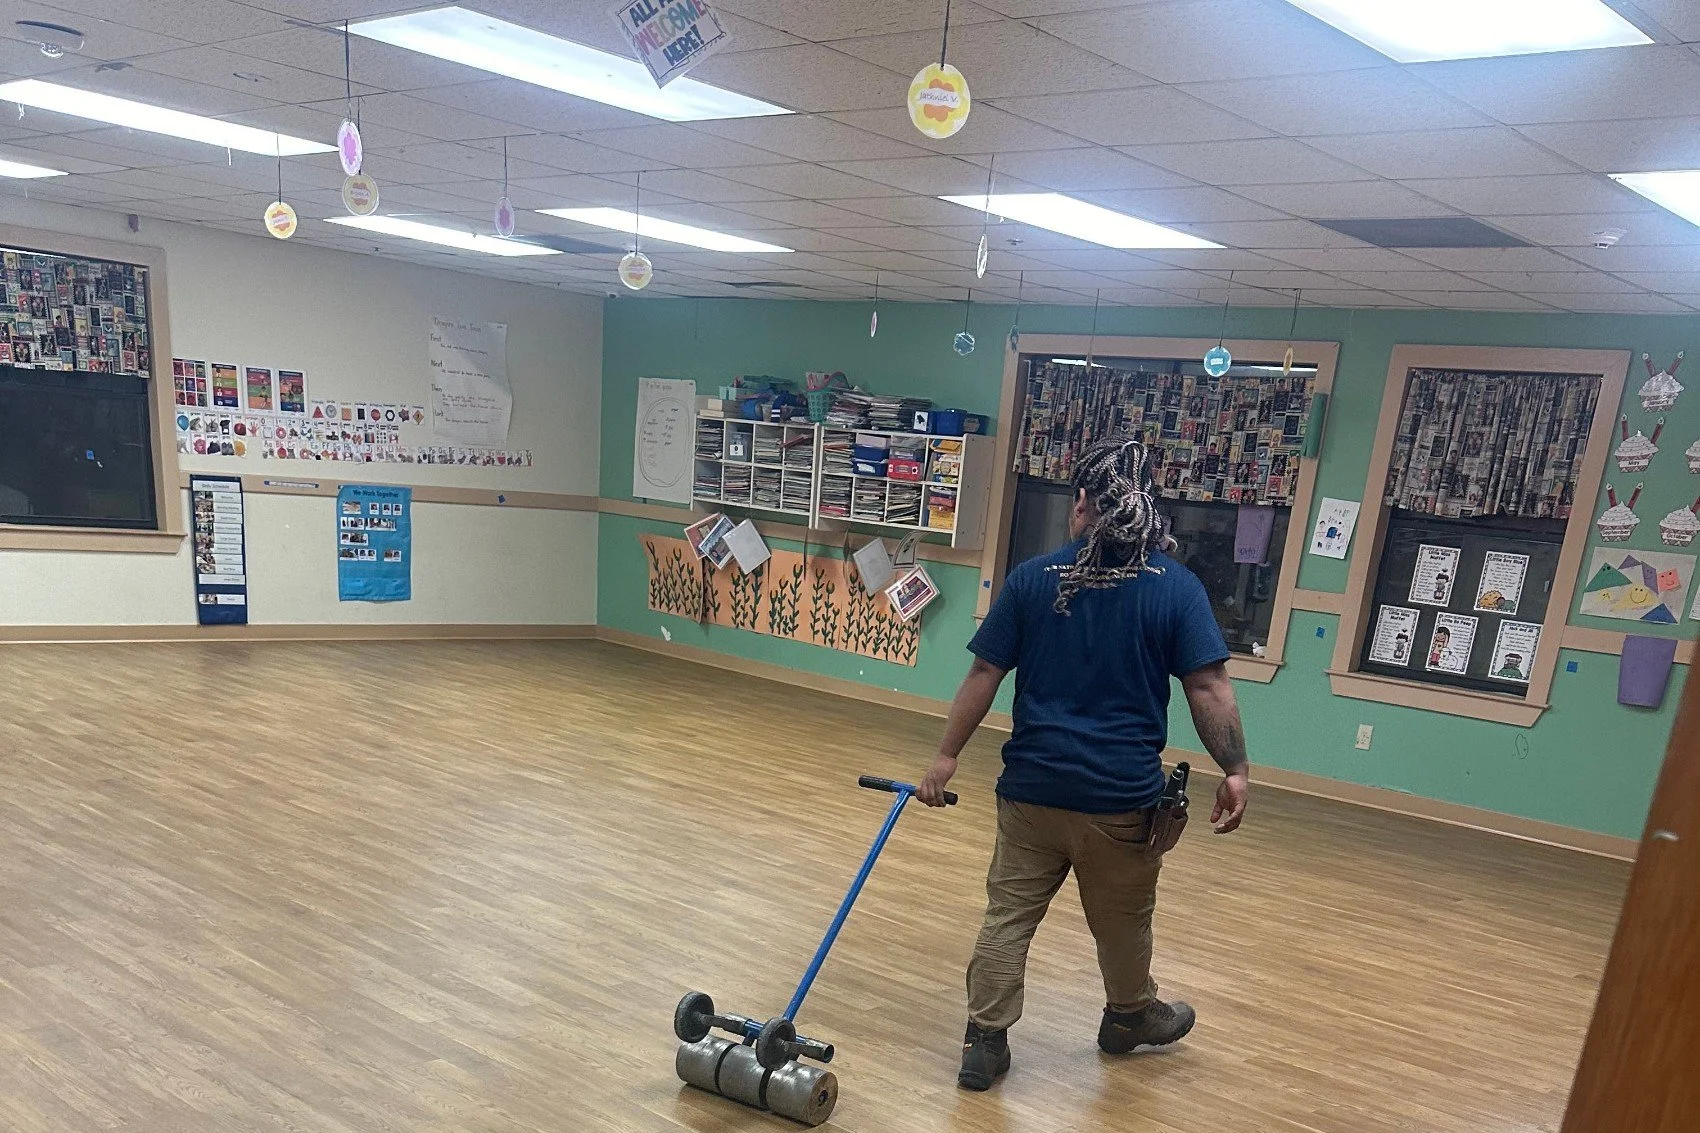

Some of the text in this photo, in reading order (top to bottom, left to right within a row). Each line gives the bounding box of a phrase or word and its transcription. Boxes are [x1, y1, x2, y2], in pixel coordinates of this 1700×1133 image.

[629, 0, 659, 28] ALL
[635, 0, 707, 55] WELCOME
[663, 24, 705, 66] HERE!
[376, 490, 399, 499] Together
